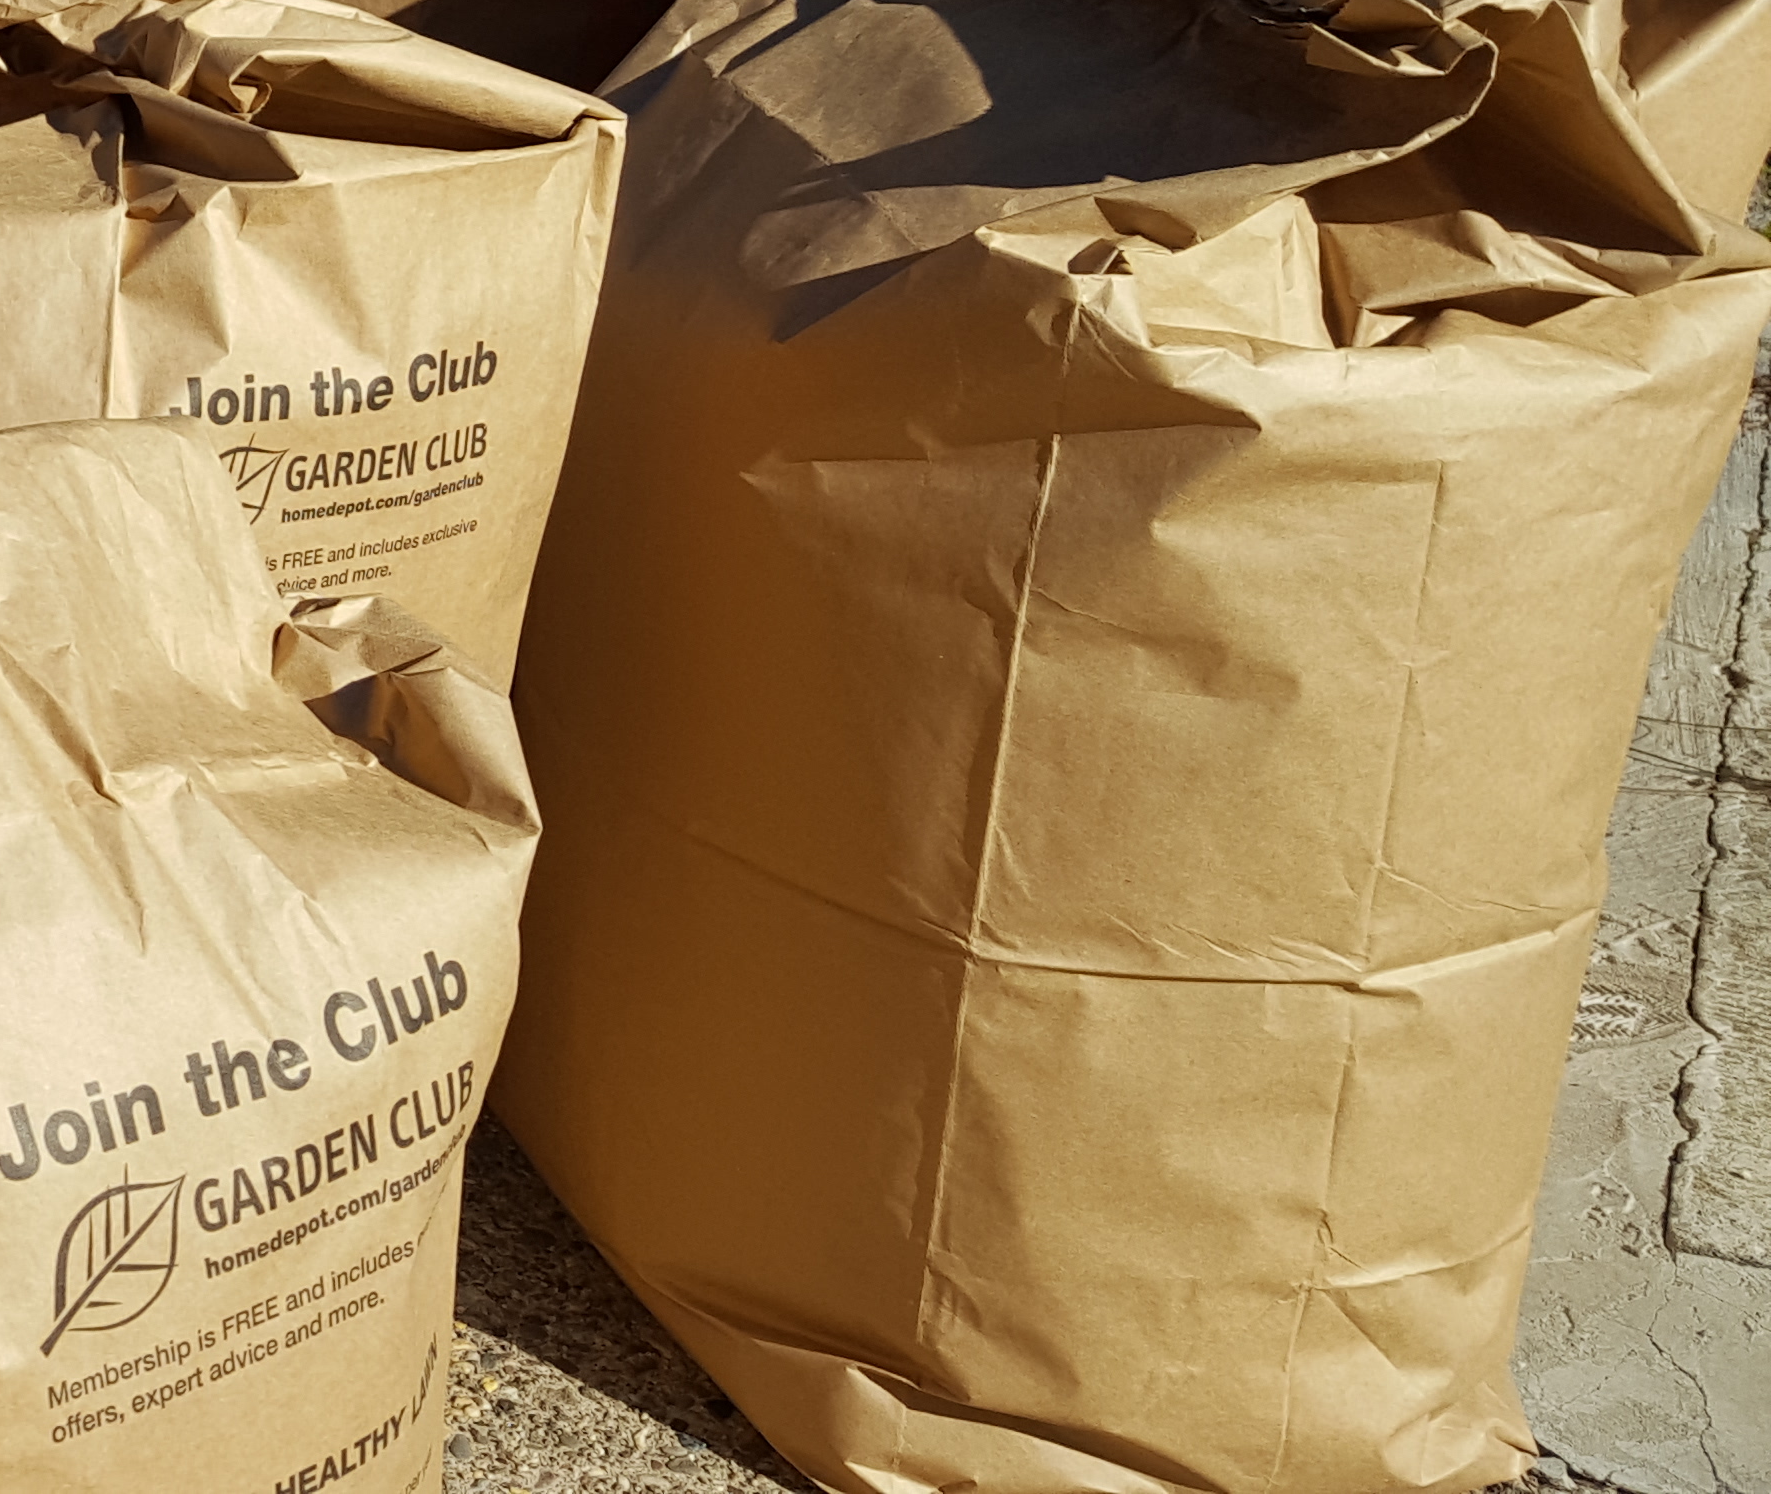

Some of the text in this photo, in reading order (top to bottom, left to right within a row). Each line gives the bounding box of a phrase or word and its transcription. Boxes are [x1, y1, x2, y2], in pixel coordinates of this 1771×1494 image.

[169, 340, 498, 425] Join the Club
[280, 472, 484, 524] homedepot.com/gardenclub
[285, 422, 487, 492] GARDEN CLUB
[276, 564, 392, 596] dvice and more.
[282, 548, 323, 570] FREE
[327, 543, 355, 563] and
[359, 538, 420, 559] includes
[422, 518, 478, 546] exclusive
[183, 1039, 312, 1118] the
[323, 950, 468, 1063] Club
[194, 1113, 378, 1233] GARDEN
[390, 1060, 474, 1148] CLUB
[204, 1122, 466, 1280] homedepot.com/garden
[47, 1240, 415, 1409] Membership is FREE and includes
[52, 1290, 385, 1444] offers, expert advice and more.
[275, 1405, 408, 1494] HEALTHY
